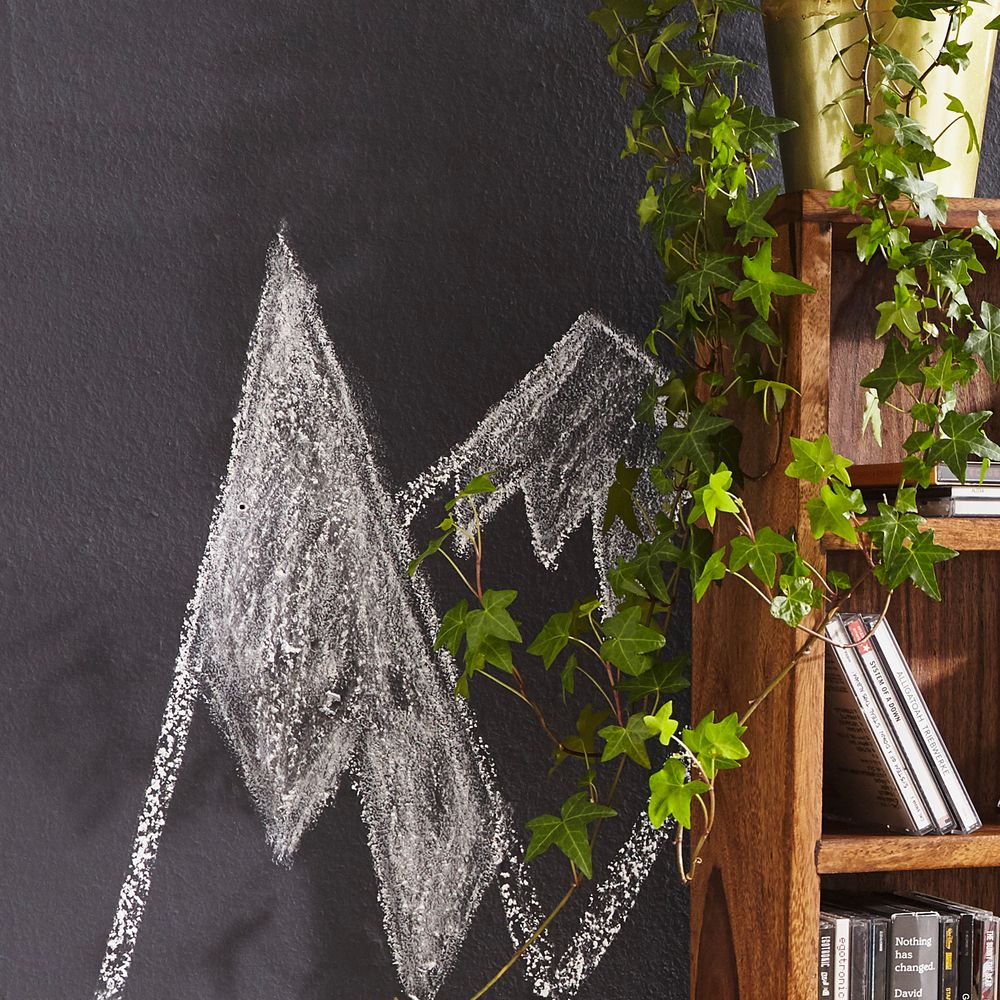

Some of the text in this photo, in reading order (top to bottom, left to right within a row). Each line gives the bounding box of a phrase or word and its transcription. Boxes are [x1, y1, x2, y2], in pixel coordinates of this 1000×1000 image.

[869, 660, 885, 687] SYSTEM
[882, 686, 890, 694] OF
[889, 702, 901, 723] DOWN
[896, 671, 950, 777] ALLIGATOAH TRIEBWERKE
[895, 937, 932, 947] Nothing
[895, 950, 913, 959] has
[837, 937, 848, 999] egotronic
[894, 962, 935, 974] changed.
[894, 989, 923, 998] David
